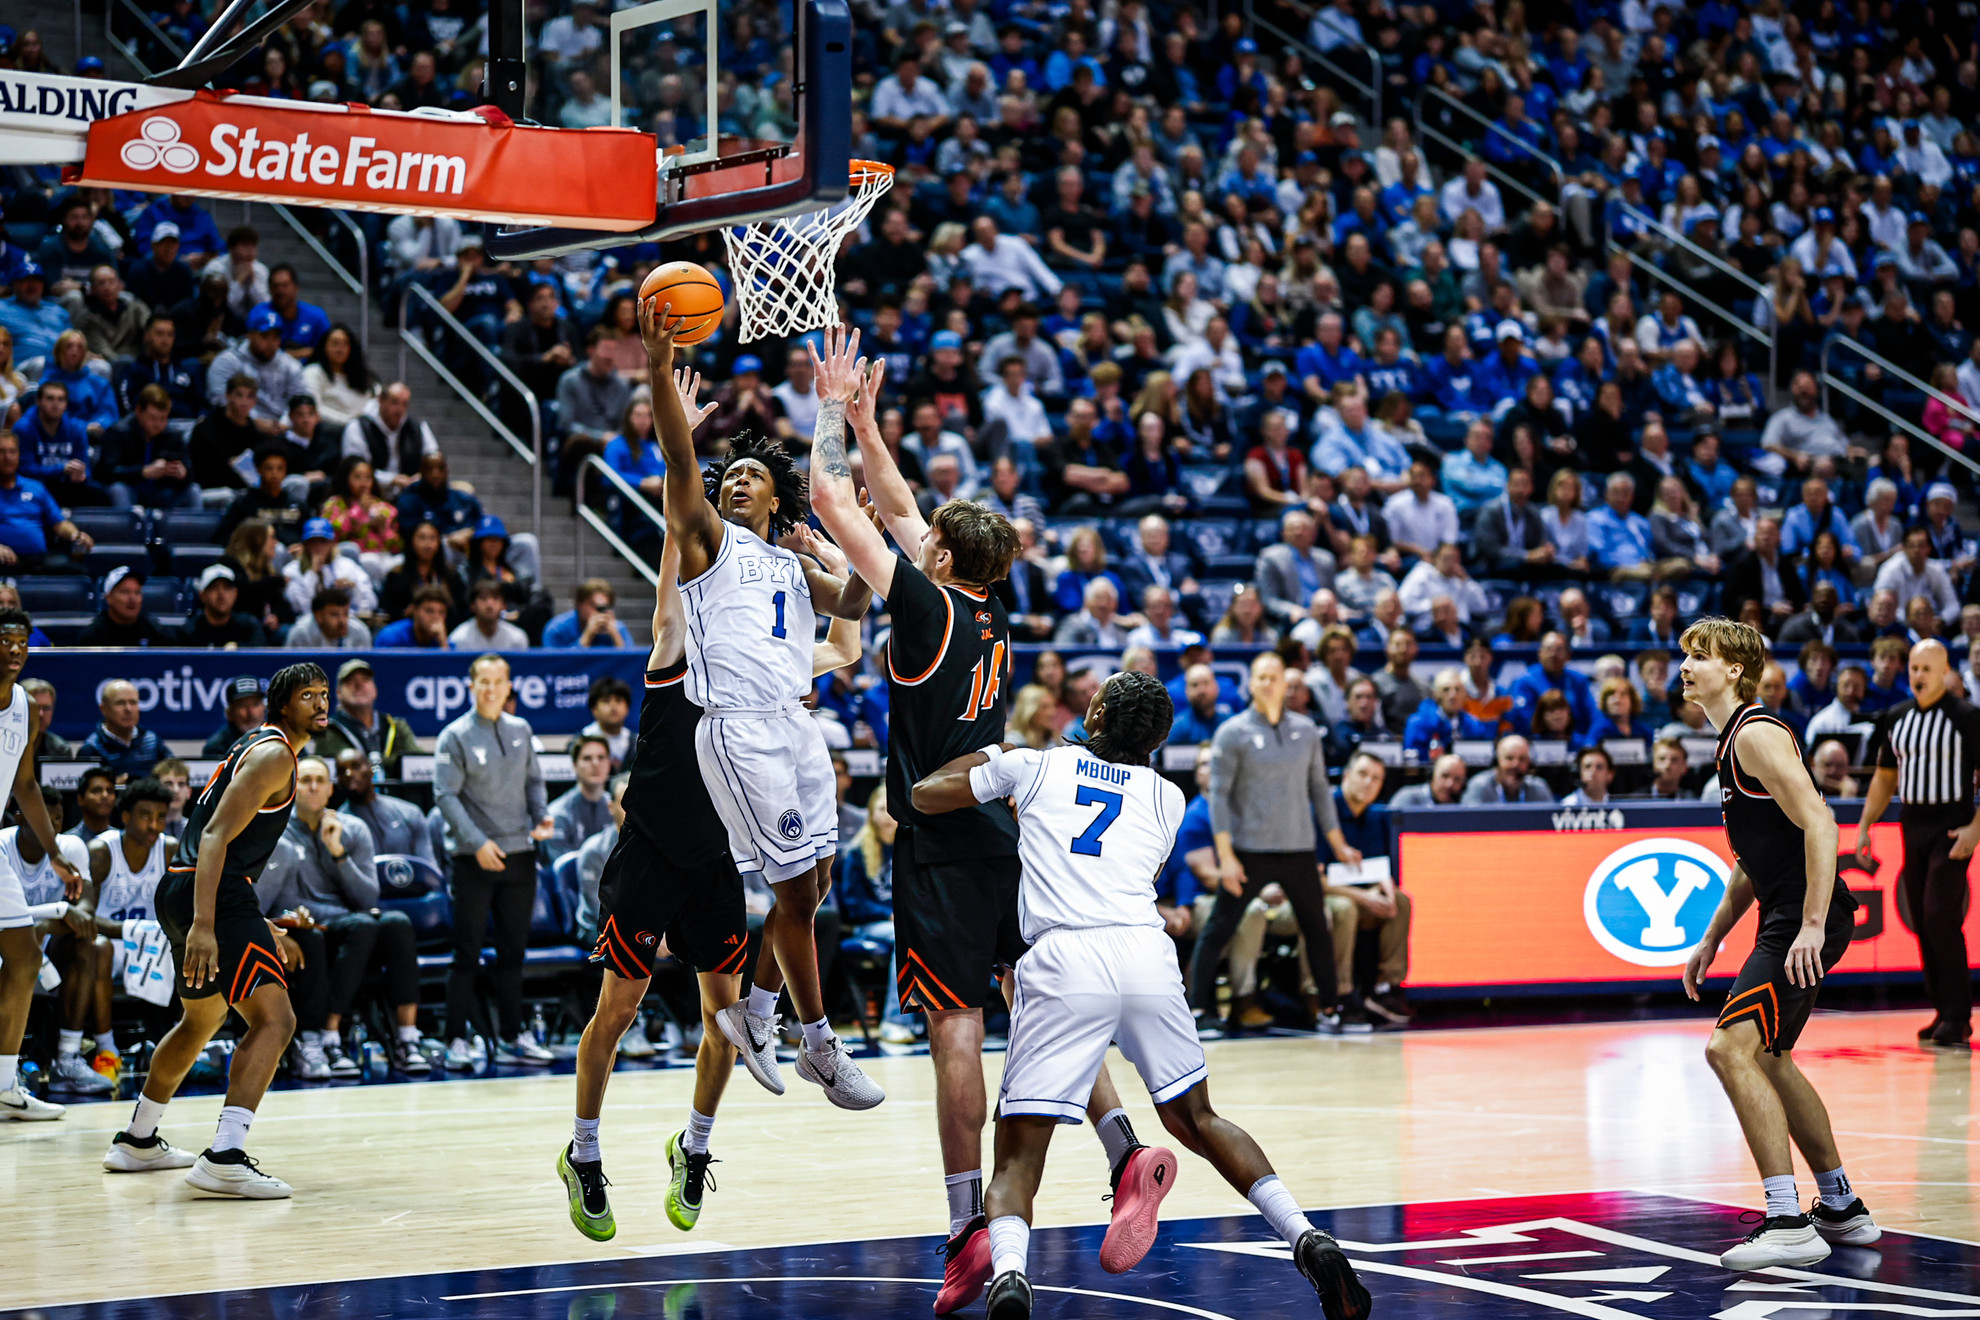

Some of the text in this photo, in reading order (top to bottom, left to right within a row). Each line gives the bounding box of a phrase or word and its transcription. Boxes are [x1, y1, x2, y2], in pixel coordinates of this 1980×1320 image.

[771, 590, 787, 640] 1
[1076, 758, 1131, 786] MBOUP
[1070, 784, 1124, 858] 7
